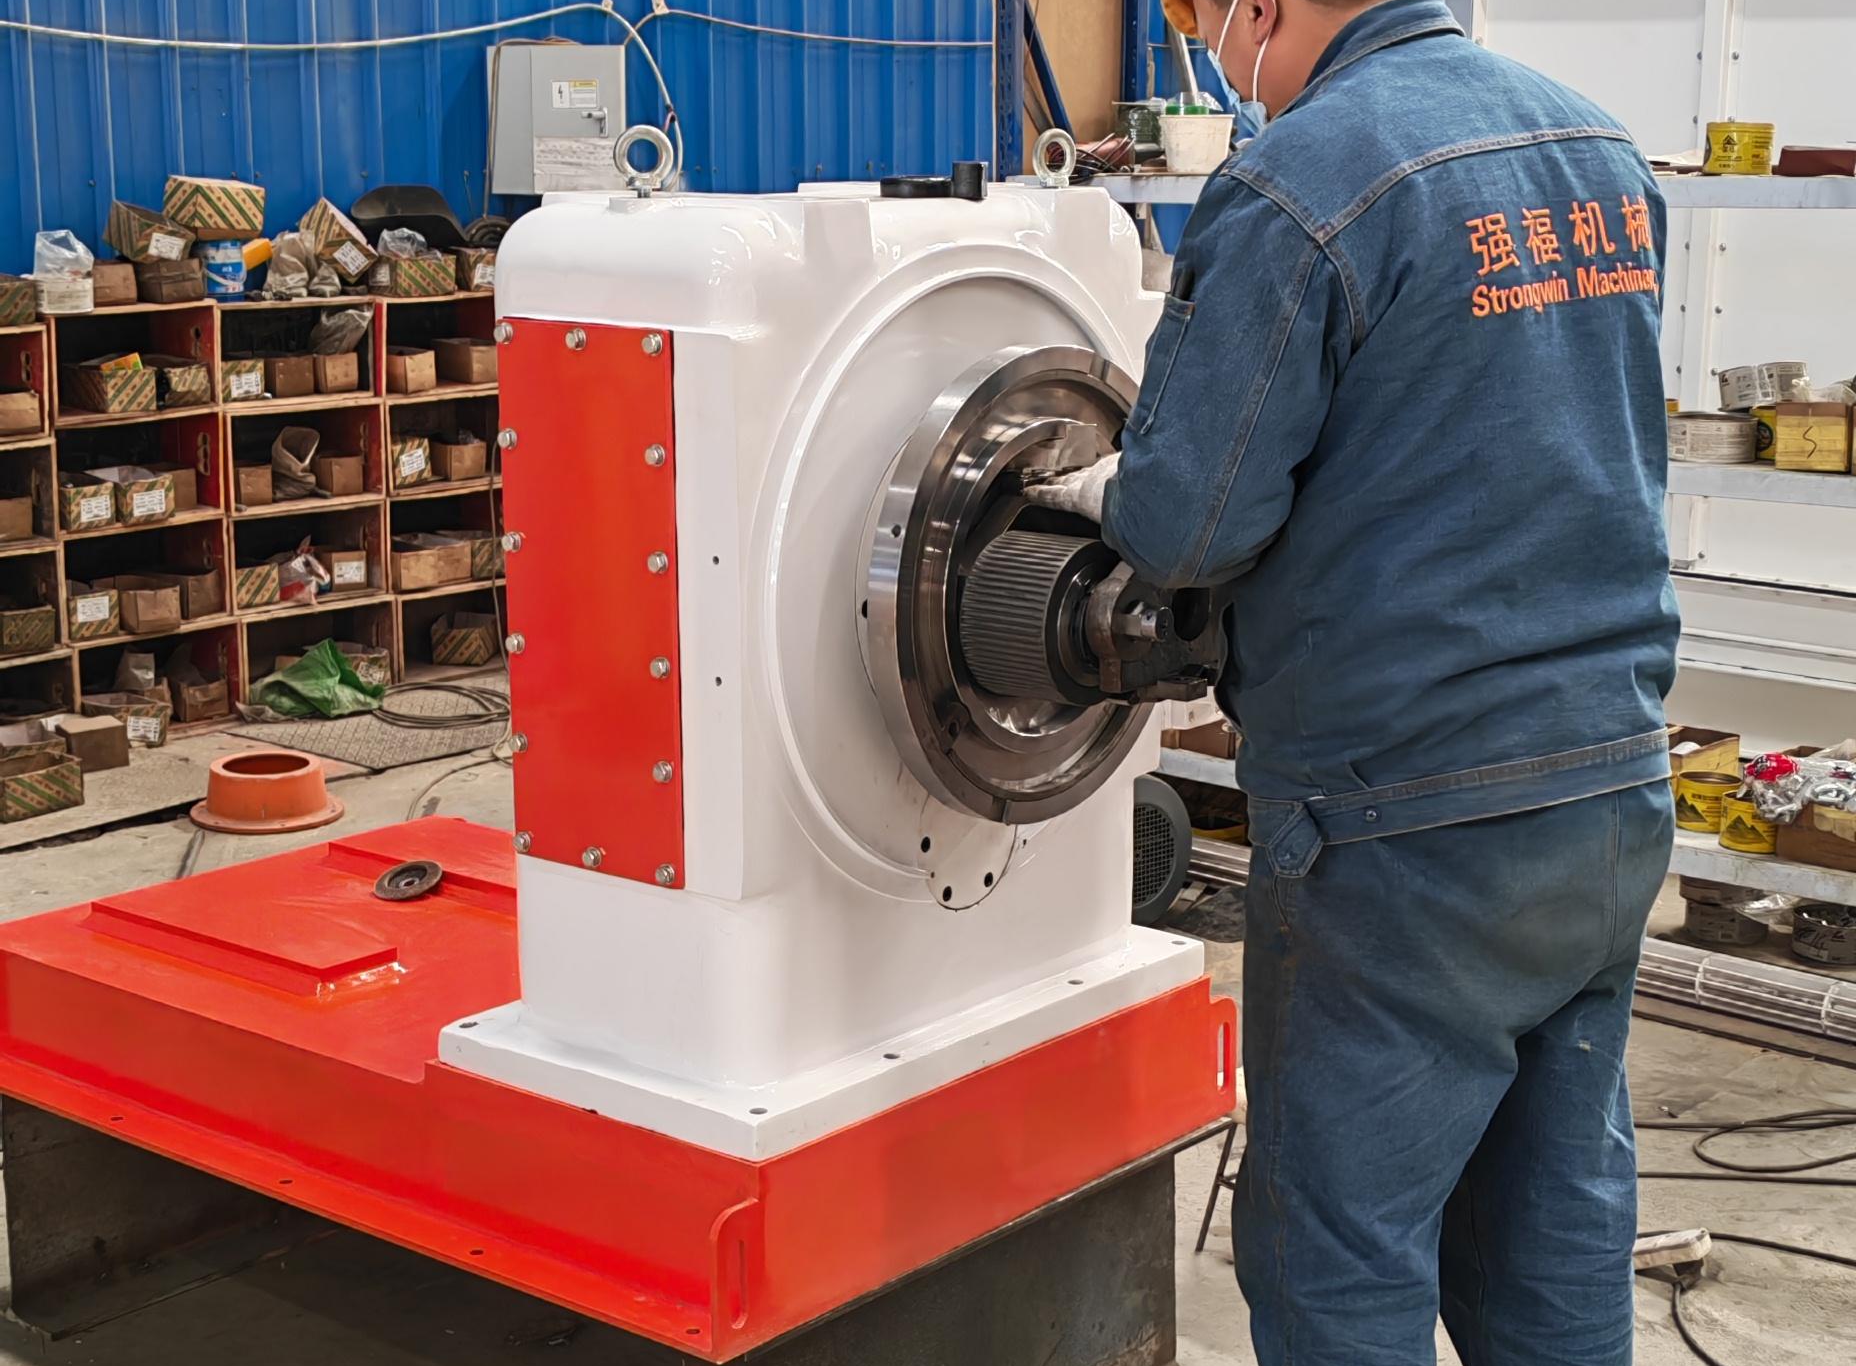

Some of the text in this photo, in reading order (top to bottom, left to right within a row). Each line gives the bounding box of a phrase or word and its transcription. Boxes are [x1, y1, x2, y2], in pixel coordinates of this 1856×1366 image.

[1464, 194, 1654, 276] 强福机械
[1471, 270, 1570, 317] Strongwin
